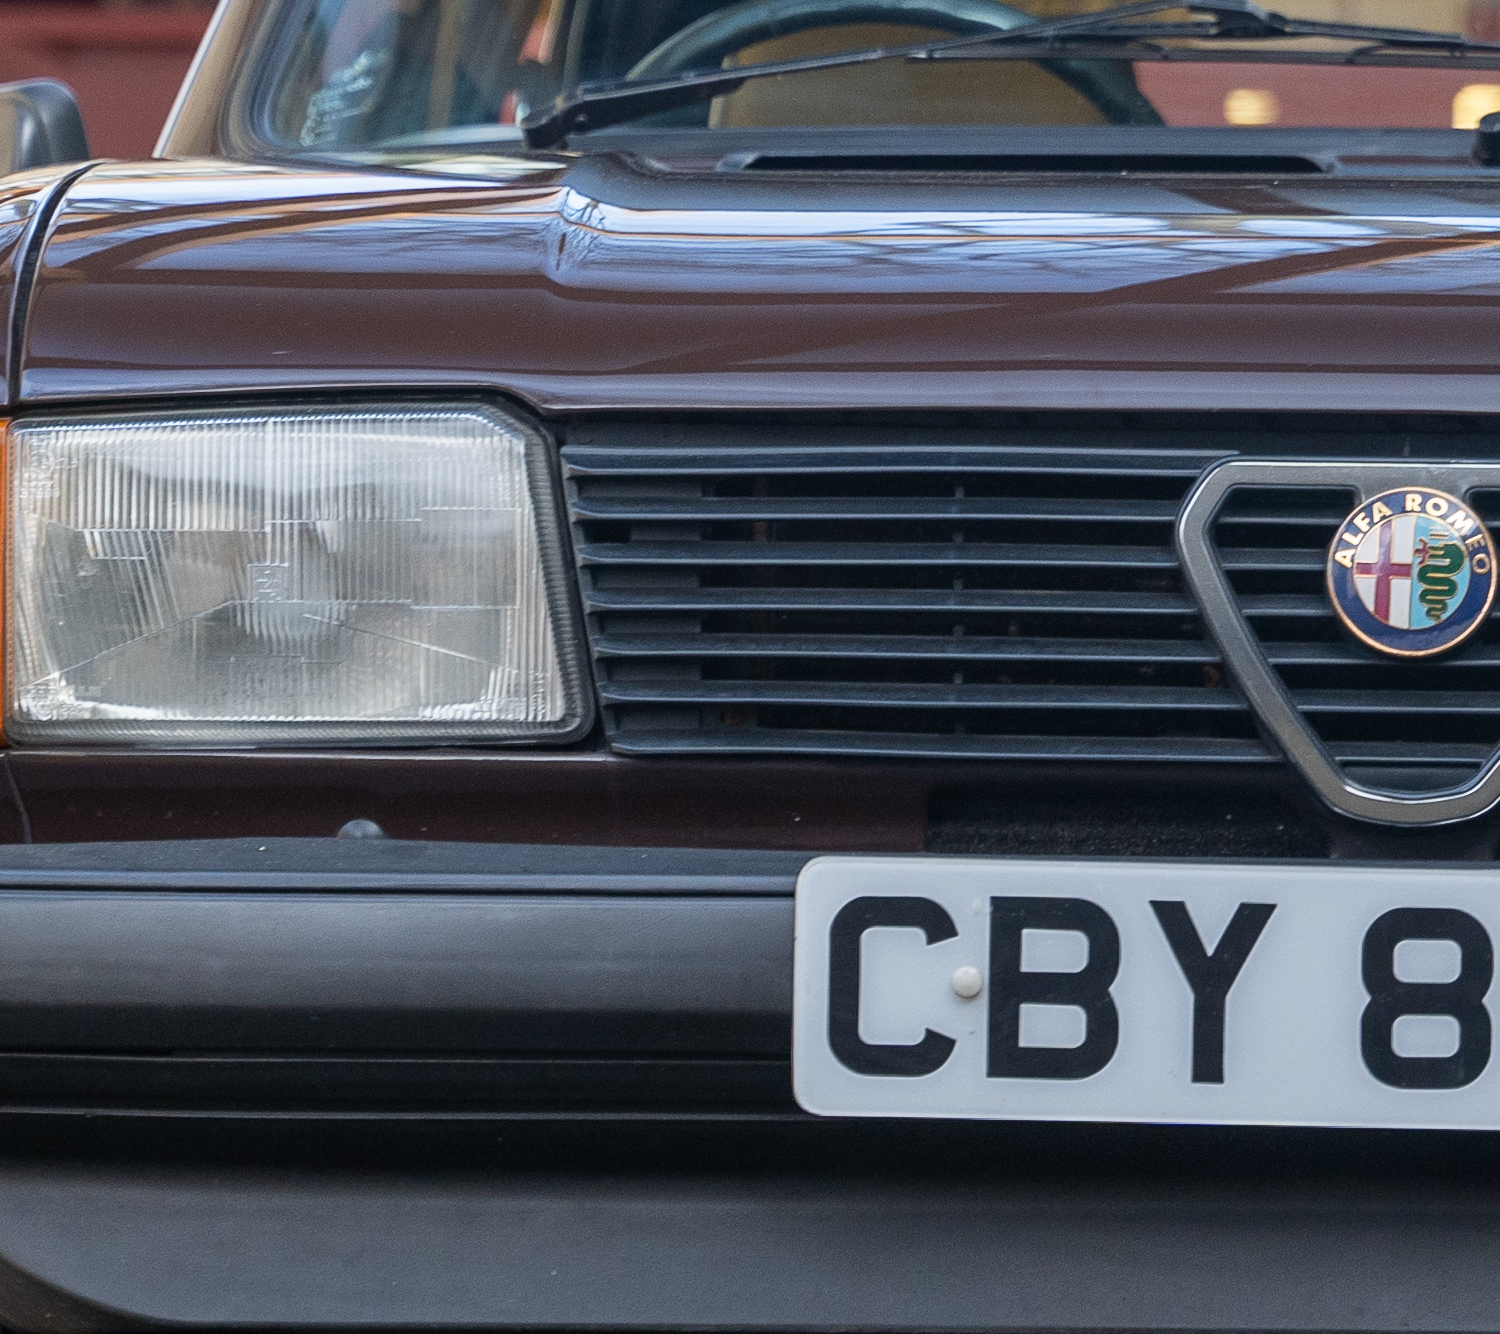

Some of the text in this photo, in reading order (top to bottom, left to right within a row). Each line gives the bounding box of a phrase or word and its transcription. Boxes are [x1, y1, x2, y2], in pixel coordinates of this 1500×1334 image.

[1334, 493, 1490, 574] ALFA ROMEO
[827, 895, 1277, 1085] CBY
